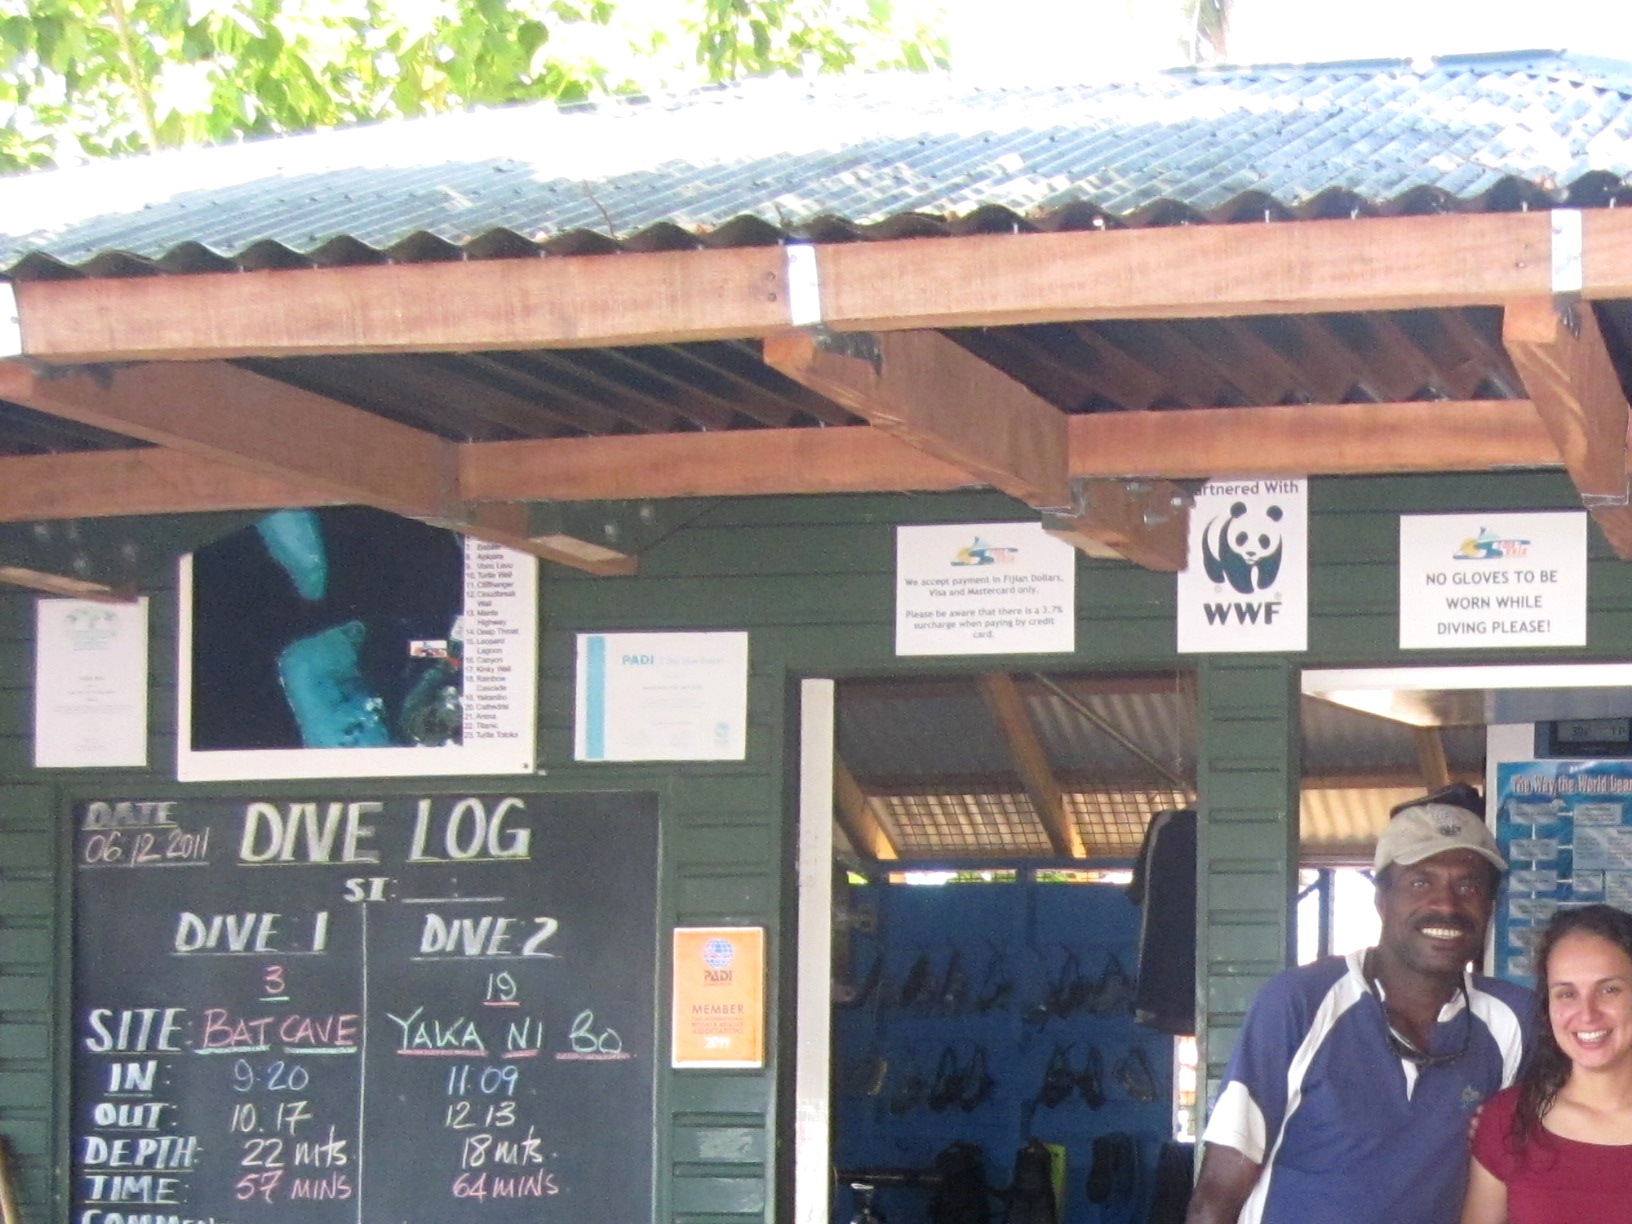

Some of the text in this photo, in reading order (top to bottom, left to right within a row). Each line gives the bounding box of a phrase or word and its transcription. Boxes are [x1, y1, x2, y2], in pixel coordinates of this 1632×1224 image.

[1265, 481, 1299, 494] With
[905, 578, 918, 586] We
[921, 578, 950, 587] accept
[952, 576, 989, 587] payment
[1426, 570, 1558, 586] NO GLOVES TO BE
[929, 588, 946, 597] Visa
[950, 587, 965, 596] and
[1445, 595, 1543, 610] WORN WHILE
[905, 610, 933, 618] Please
[936, 609, 947, 618] be
[978, 608, 996, 616] that
[998, 607, 1023, 615] there
[1203, 602, 1282, 626] WWF
[914, 620, 956, 630] surcharge
[959, 619, 982, 628] when
[984, 618, 1013, 628] paying
[1028, 616, 1054, 625] credit
[1437, 620, 1551, 635] DIVING PLEASE!
[622, 654, 654, 665] PADI
[1534, 775, 1556, 796] Way
[1558, 776, 1574, 793] the
[1578, 775, 1605, 792] World
[85, 797, 532, 863] DATE DIVE LOG
[174, 912, 329, 953] DIVE 1
[420, 913, 559, 957] DIVE 2
[265, 966, 286, 994] 3
[704, 970, 733, 982] PADI
[486, 971, 518, 1001] 19
[692, 1004, 744, 1015] MEMBER
[387, 1006, 486, 1050] YAKA
[507, 1016, 543, 1050] NI
[241, 1139, 285, 1168] 22
[236, 1170, 285, 1204] 57
[452, 1172, 488, 1200] 64
